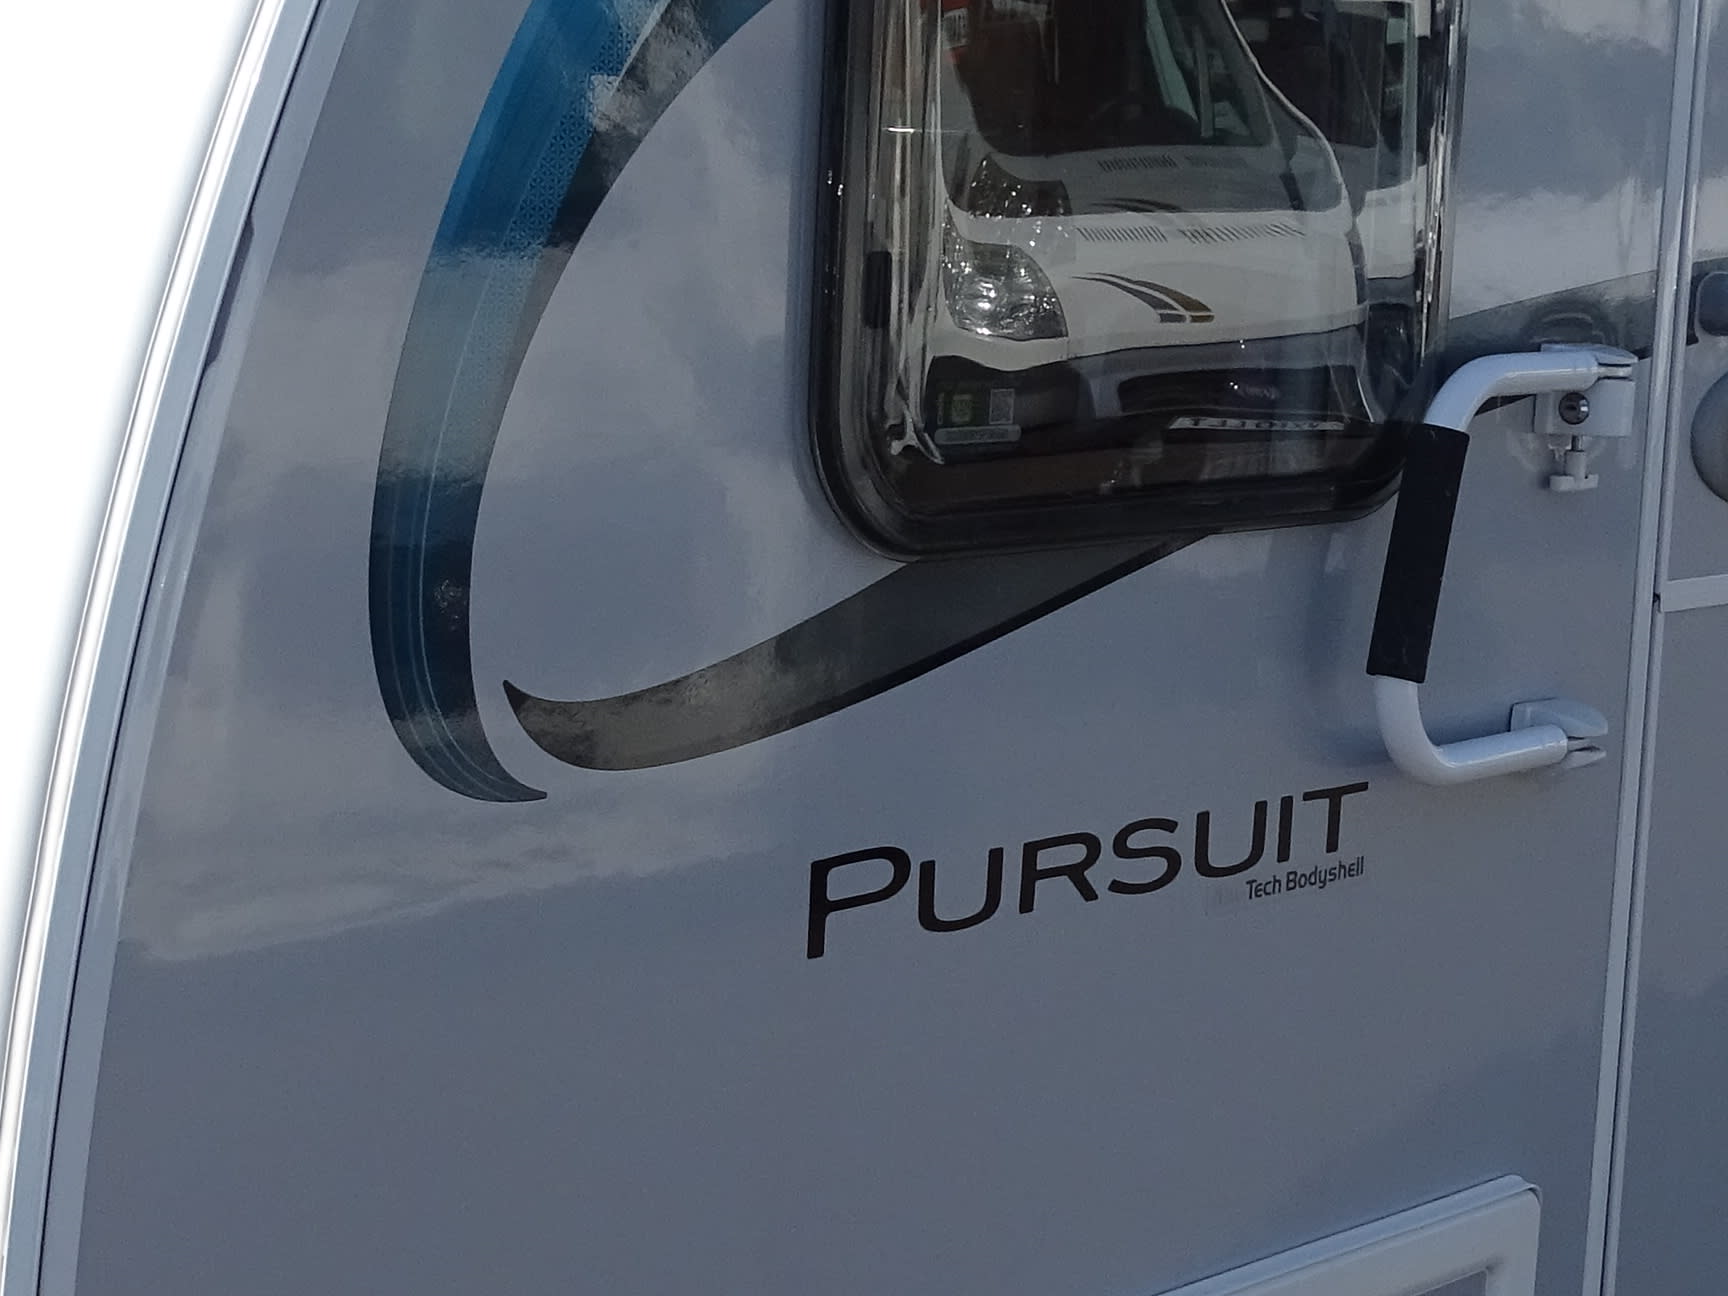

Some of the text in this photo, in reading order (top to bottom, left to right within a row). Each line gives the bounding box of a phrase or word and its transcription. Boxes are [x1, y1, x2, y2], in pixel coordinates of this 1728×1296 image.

[807, 781, 1370, 960] PURSUIT
[1246, 855, 1365, 900] Tech Bodyshell
